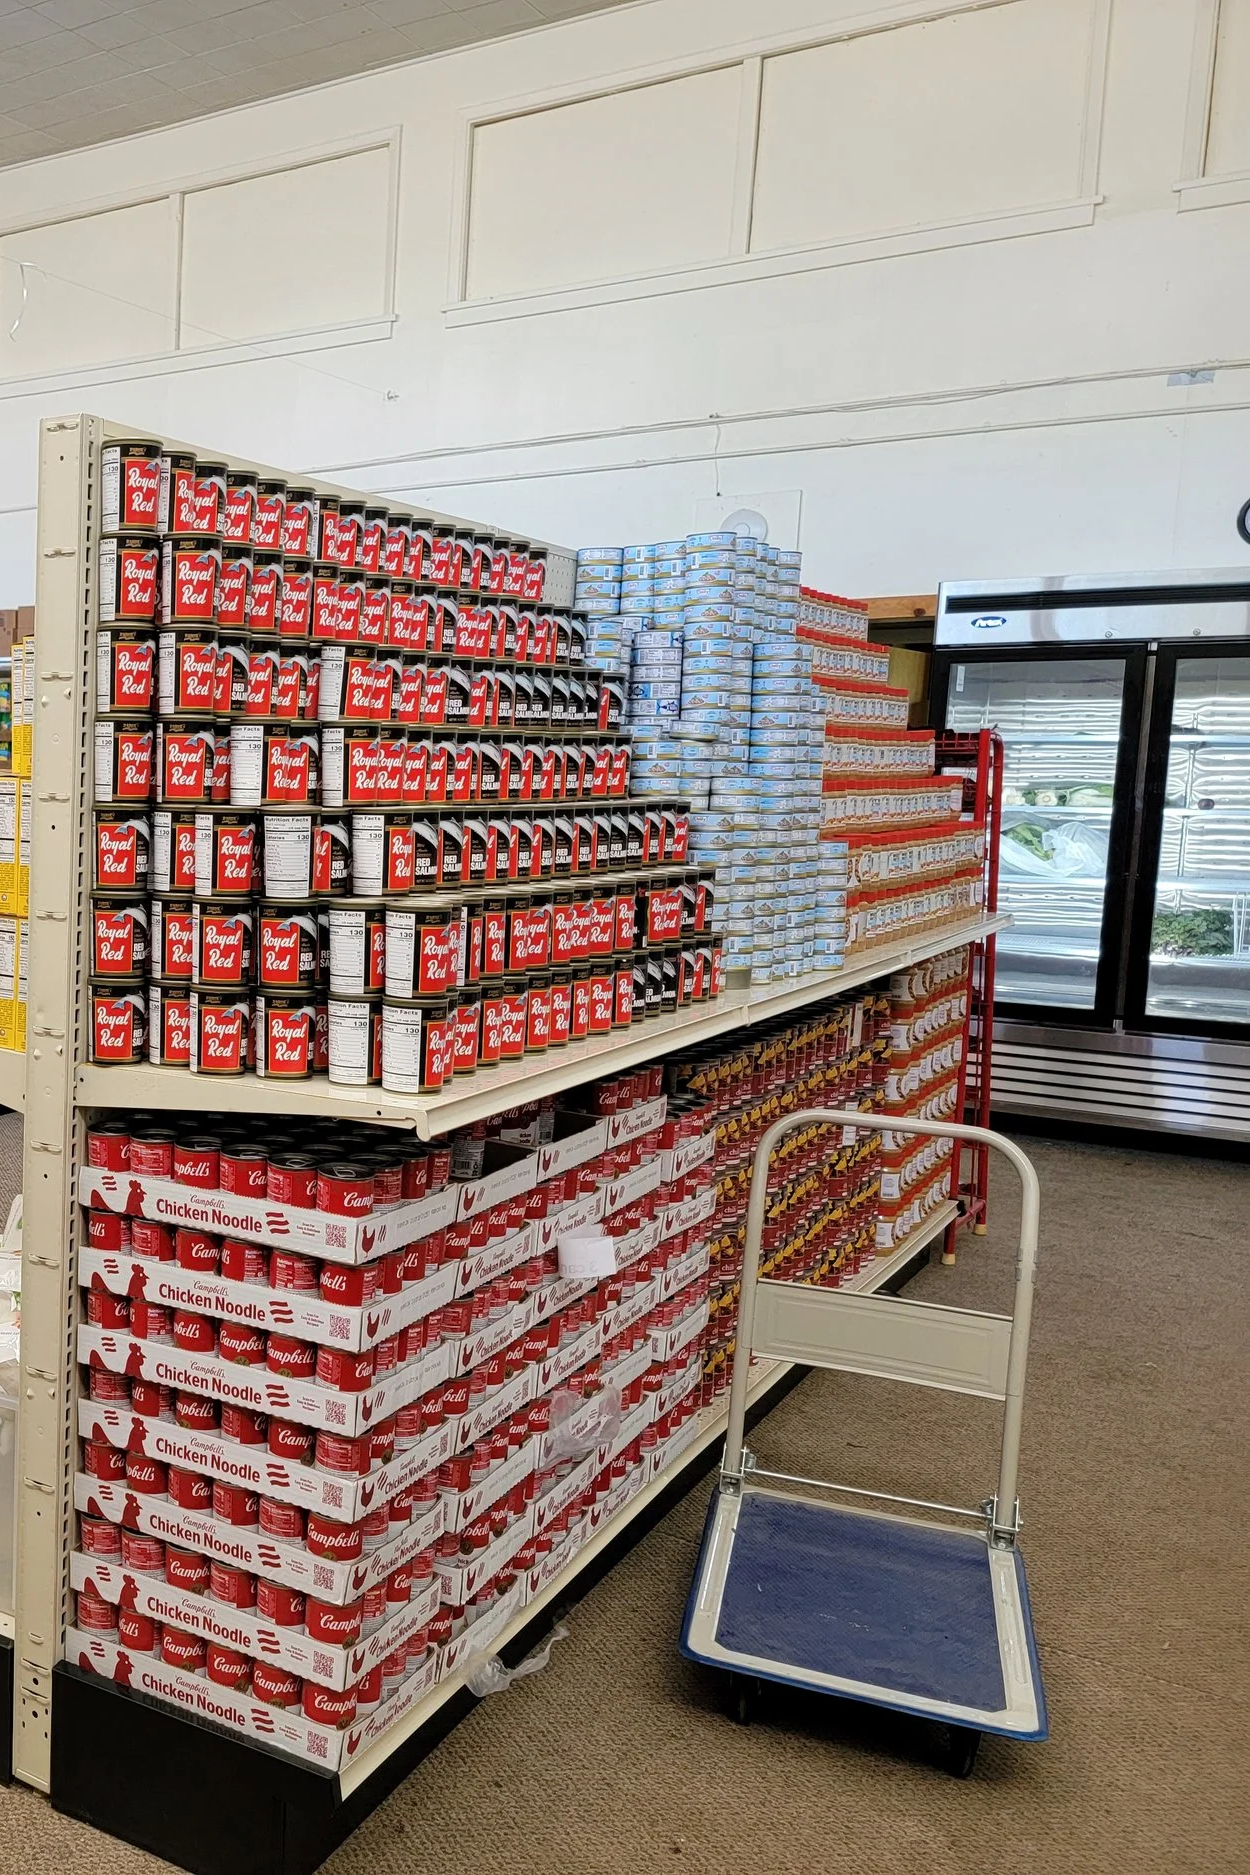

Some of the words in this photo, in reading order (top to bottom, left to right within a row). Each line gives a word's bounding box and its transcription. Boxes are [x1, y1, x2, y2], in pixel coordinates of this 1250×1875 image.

[128, 468, 158, 492] Royal
[132, 492, 154, 512] Red
[124, 559, 156, 584] Royal
[179, 561, 212, 586] Royal
[128, 583, 152, 603] Red
[182, 585, 207, 605] Red
[282, 582, 308, 604] Royal
[283, 604, 304, 623] Red
[118, 652, 150, 676] Royal
[184, 652, 214, 678] Royal
[121, 675, 146, 694] Red
[187, 676, 210, 696] Red
[122, 742, 150, 767] Royal
[168, 743, 204, 768] Royal
[125, 766, 147, 785] Red
[172, 766, 197, 786] Red
[100, 832, 134, 856] Royal
[221, 836, 252, 862] Royal
[104, 854, 128, 873] Red
[224, 859, 246, 879] Red
[332, 860, 345, 870] RED
[416, 858, 432, 866] RED
[444, 856, 458, 864] RED
[98, 920, 129, 945] Royal
[206, 926, 239, 952] Royal
[263, 928, 296, 955] Royal
[101, 942, 124, 961] Red
[209, 949, 234, 969] Red
[266, 952, 290, 972] Red
[300, 953, 312, 962] RED
[427, 960, 446, 980] Red
[97, 1006, 129, 1032] Royal
[204, 1014, 238, 1042] Royal
[100, 1028, 124, 1048] Red
[272, 1018, 306, 1046] Royal
[208, 1038, 233, 1057] Red
[275, 1041, 300, 1061] Red
[156, 1198, 208, 1222] Chicken
[212, 1206, 262, 1232] Noodle
[159, 1284, 212, 1309] Chicken
[216, 1296, 266, 1322] Noodle
[156, 1362, 208, 1390] Chicken
[212, 1376, 262, 1404] Noodle
[156, 1438, 208, 1466] Chicken
[212, 1454, 260, 1482] Noodle
[384, 1474, 407, 1494] Chicken
[407, 1460, 428, 1481] Noodle
[150, 1514, 201, 1544] Chicken
[204, 1532, 252, 1562] Noodle
[148, 1596, 200, 1628] Chicken
[202, 1615, 252, 1647] Noodle
[142, 1674, 194, 1706] Chicken
[196, 1696, 246, 1726] Noodle
